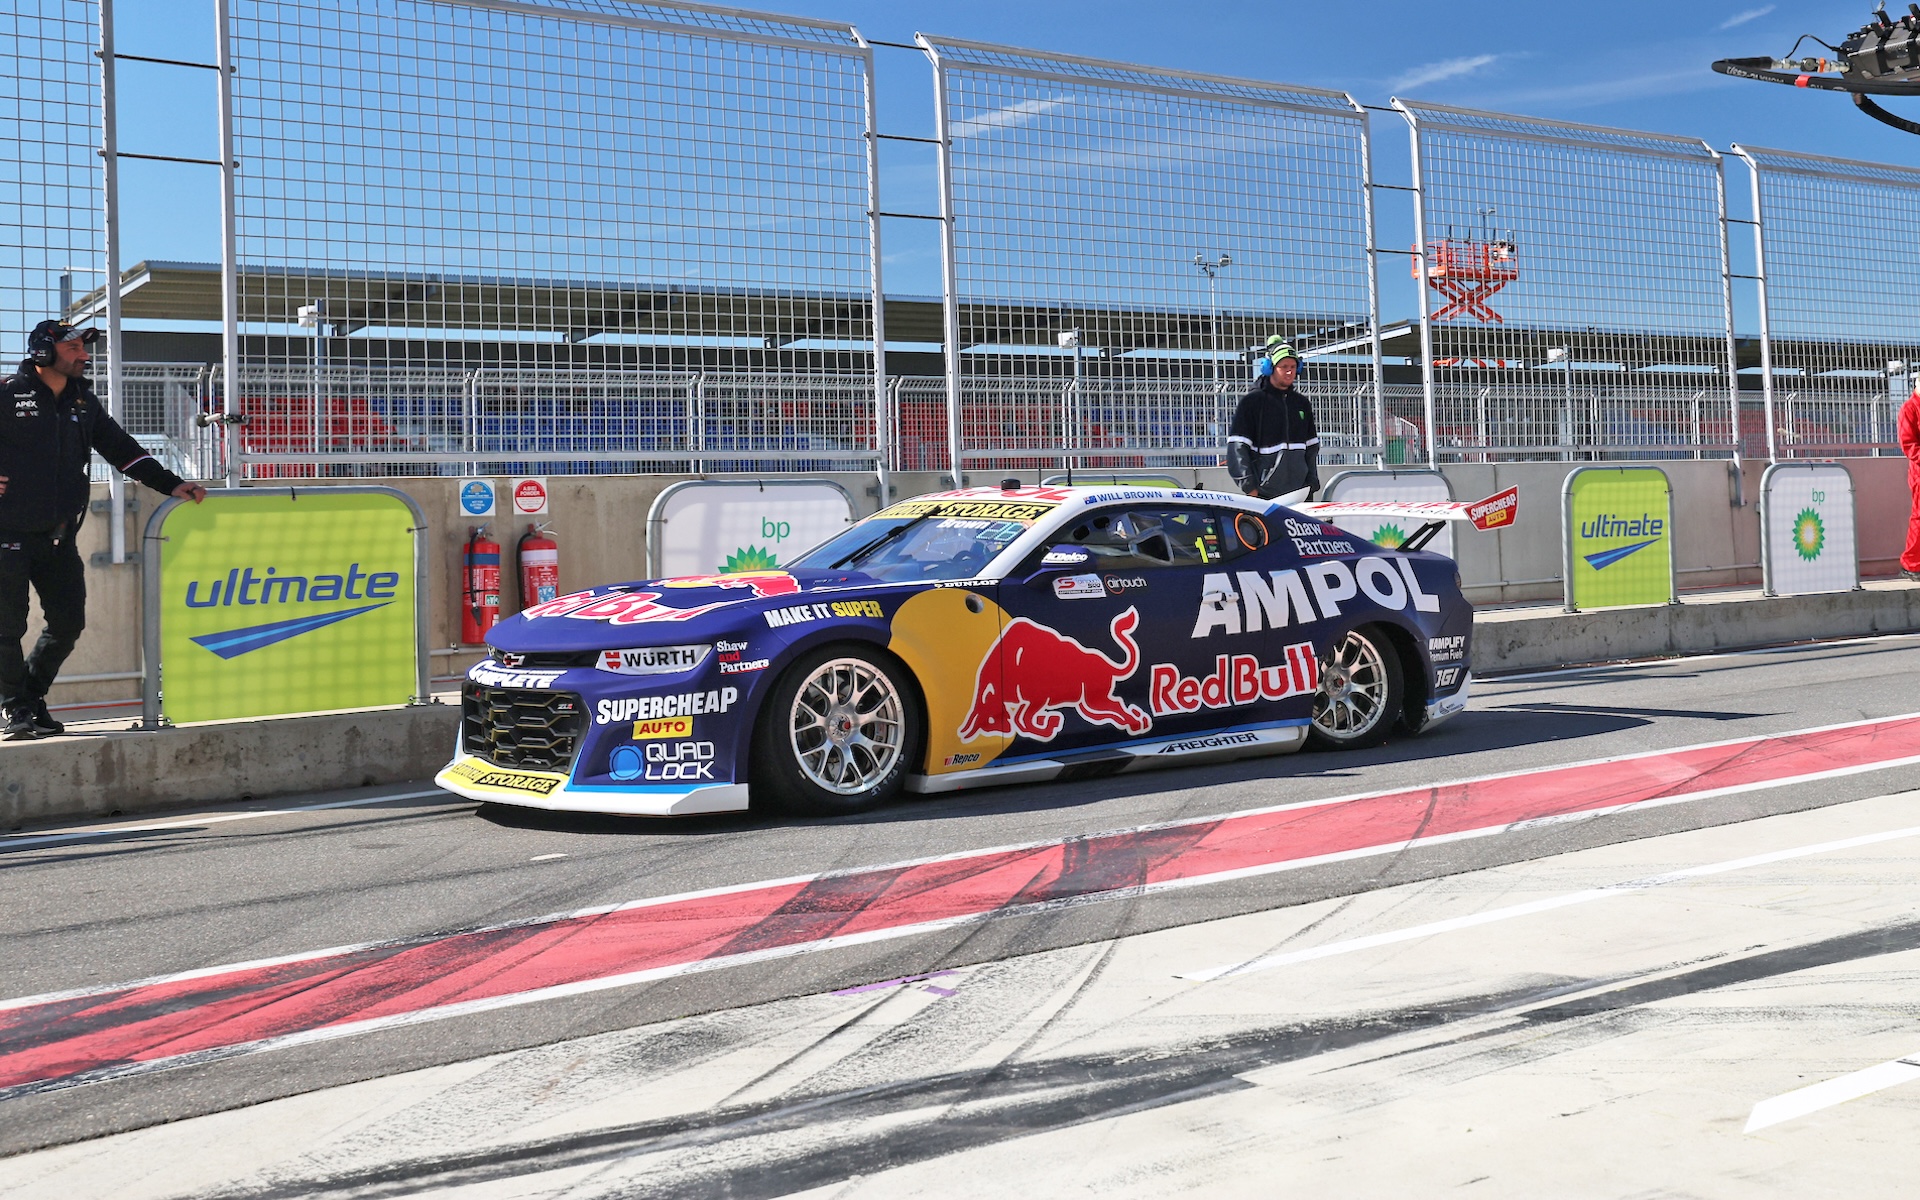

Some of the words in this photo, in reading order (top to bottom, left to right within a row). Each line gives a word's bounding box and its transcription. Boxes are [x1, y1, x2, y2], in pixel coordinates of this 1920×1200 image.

[1097, 492, 1121, 501] WILL
[1125, 491, 1163, 499] BROWN
[1812, 488, 1826, 505] bp
[938, 503, 1043, 518] STORAGE
[1471, 493, 1516, 521] SUPERCHEAP
[936, 519, 990, 530] Brown
[1488, 512, 1505, 523] AUTO
[1581, 513, 1663, 538] ultimate
[762, 517, 790, 543] bp
[1285, 518, 1322, 537] Shaw
[1195, 537, 1208, 563] 1
[1291, 538, 1355, 556] Partners
[185, 563, 399, 607] ultimate
[945, 579, 998, 588] DUNLOP
[1107, 577, 1147, 588] airtouch
[1191, 557, 1440, 638] AMPOL
[763, 605, 815, 628] MAKE
[811, 603, 832, 618] IT
[831, 600, 884, 617] SUPER
[717, 641, 747, 652] Shaw
[1430, 636, 1465, 650] AMPLIFY
[719, 651, 740, 661] and
[1450, 648, 1463, 660] Fuels
[720, 658, 769, 673] Partners
[1151, 655, 1231, 716] Red
[1232, 642, 1318, 705] Bull
[596, 686, 737, 725] SUPERCHEAP
[639, 721, 685, 734] AUTO
[646, 741, 714, 761] QUAD
[1171, 733, 1259, 753] FREIGHTER
[952, 753, 980, 765] Repco
[645, 761, 714, 780] LOCK
[484, 773, 556, 792] STORAGE
